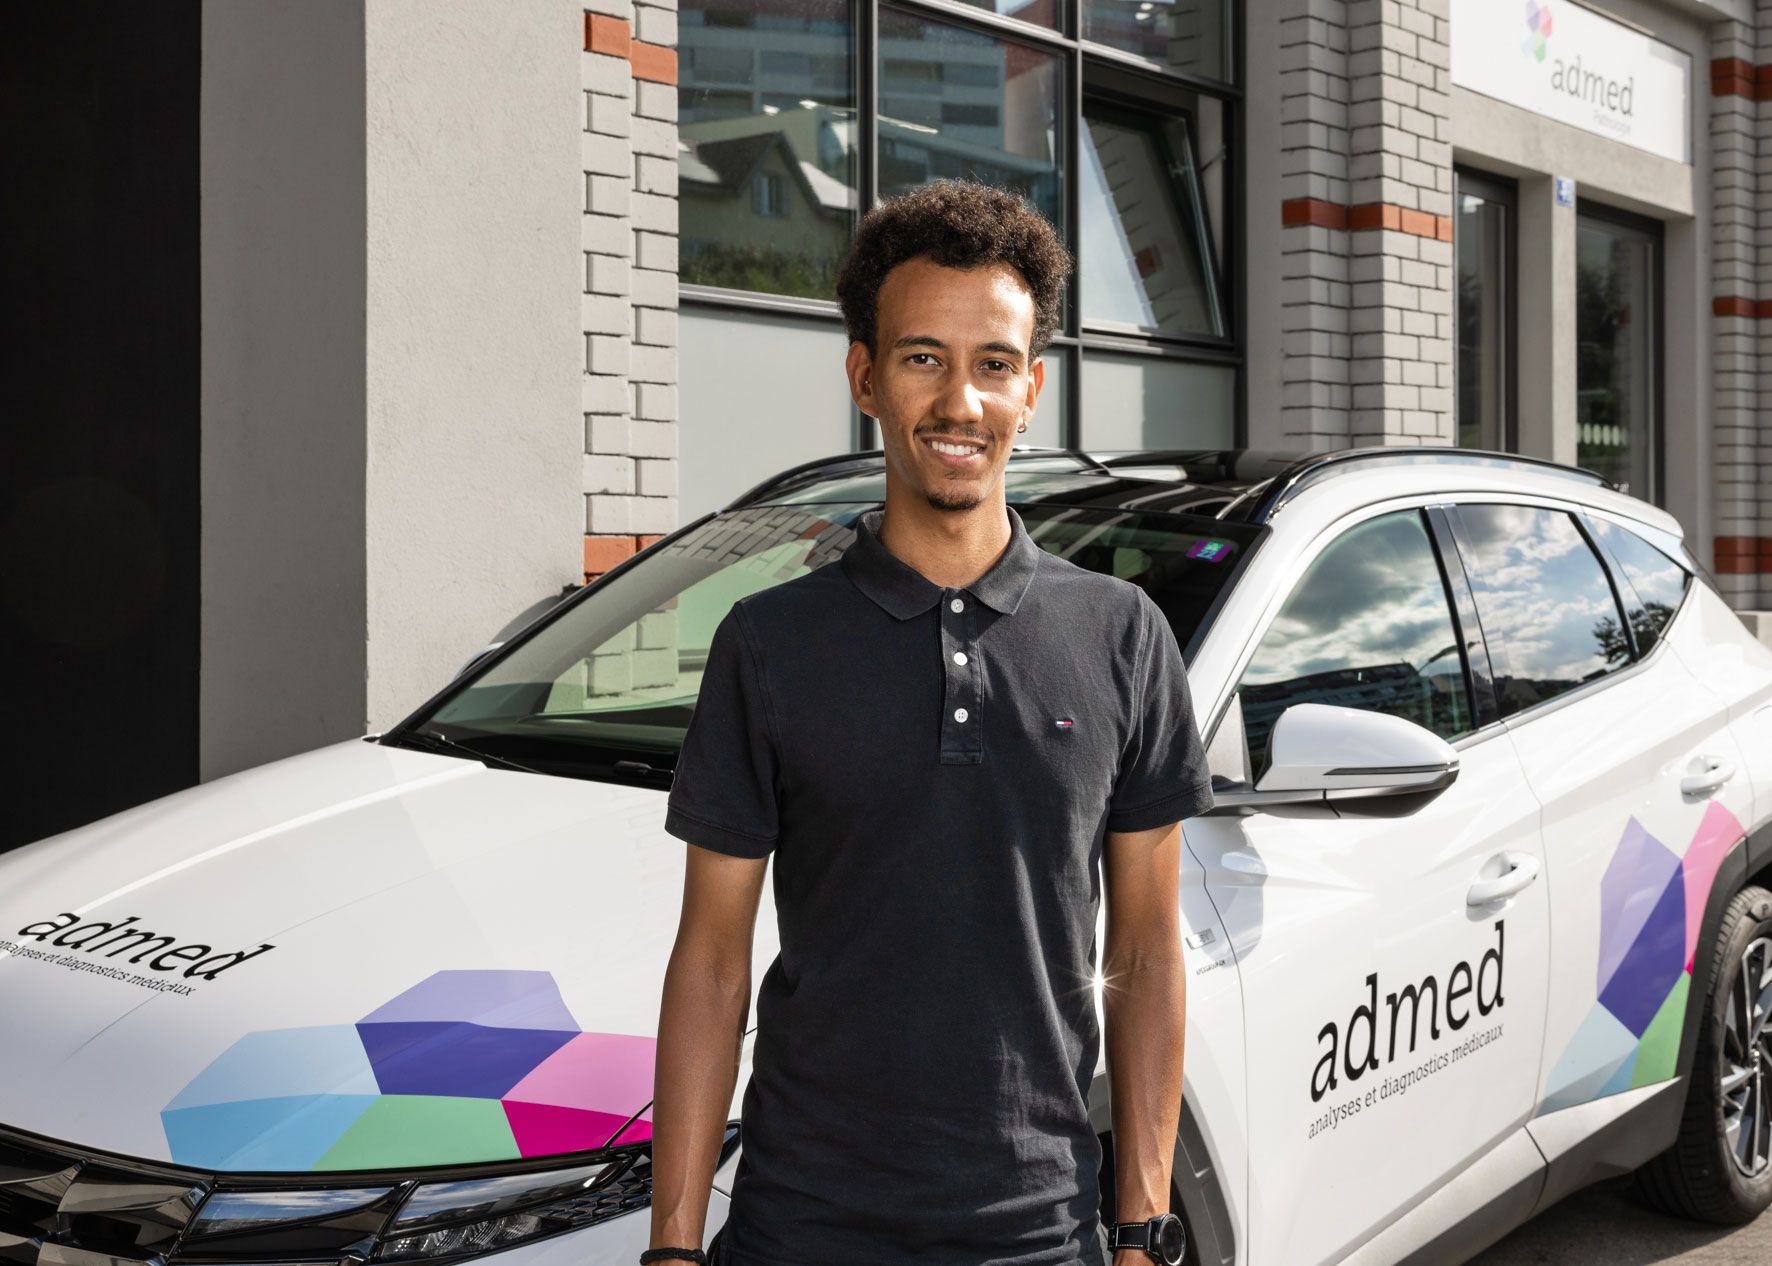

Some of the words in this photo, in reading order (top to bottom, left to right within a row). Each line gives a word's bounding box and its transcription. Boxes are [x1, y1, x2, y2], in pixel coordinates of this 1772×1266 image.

[1551, 55, 1634, 117] admed
[18, 912, 277, 981] admed
[43, 953, 61, 963] et
[56, 955, 130, 981] diagnostics
[127, 975, 197, 997] médicaux
[1311, 919, 1505, 1103] admed
[1308, 1097, 1362, 1139] analyses
[1364, 1086, 1378, 1107] et
[1380, 1051, 1450, 1096] diagnostics
[1451, 1023, 1505, 1064] médicaux
